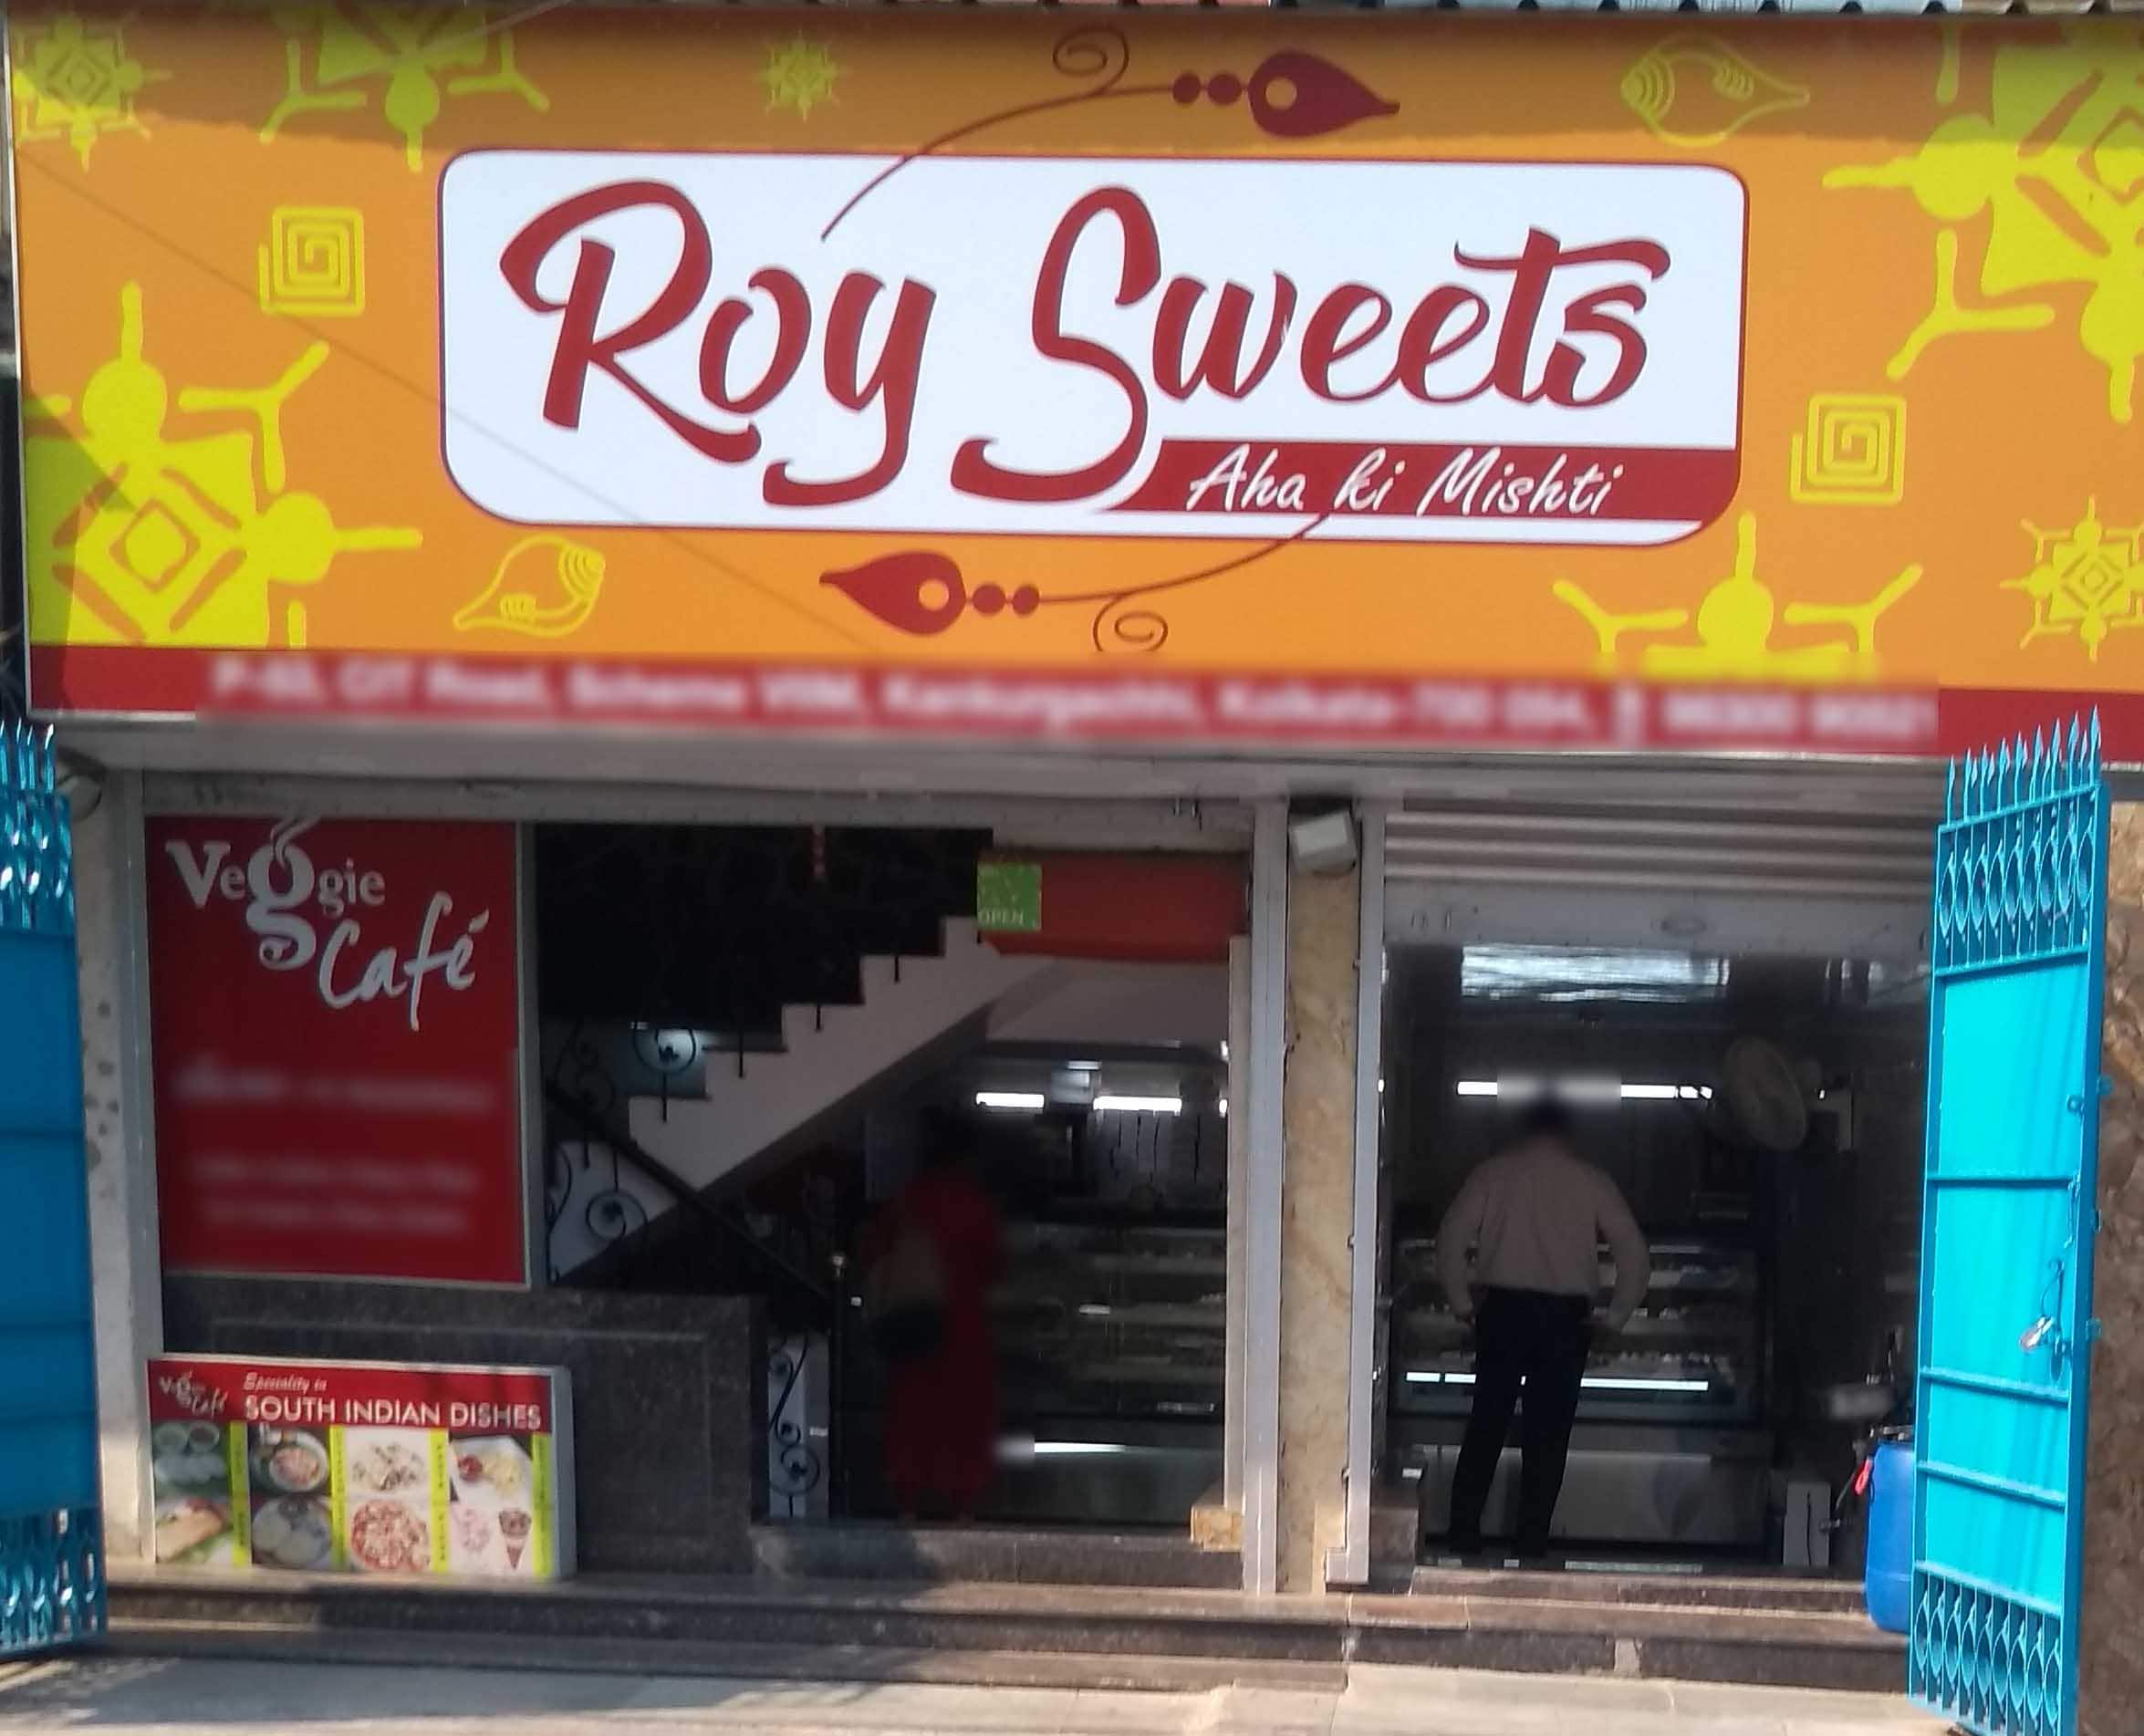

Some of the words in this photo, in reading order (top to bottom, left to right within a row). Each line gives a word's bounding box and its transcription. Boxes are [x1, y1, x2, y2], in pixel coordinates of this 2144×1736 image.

[499, 182, 936, 510] Roy
[952, 188, 1670, 510] Sweets
[1186, 443, 1305, 512] Aha
[1333, 447, 1406, 512] ki
[1416, 446, 1624, 517] Mishti
[165, 817, 386, 971] Veggie
[319, 890, 489, 1033] Café
[245, 1395, 336, 1422] SOUTH
[346, 1398, 441, 1426] INDIAN
[450, 1401, 541, 1430] DISHES
